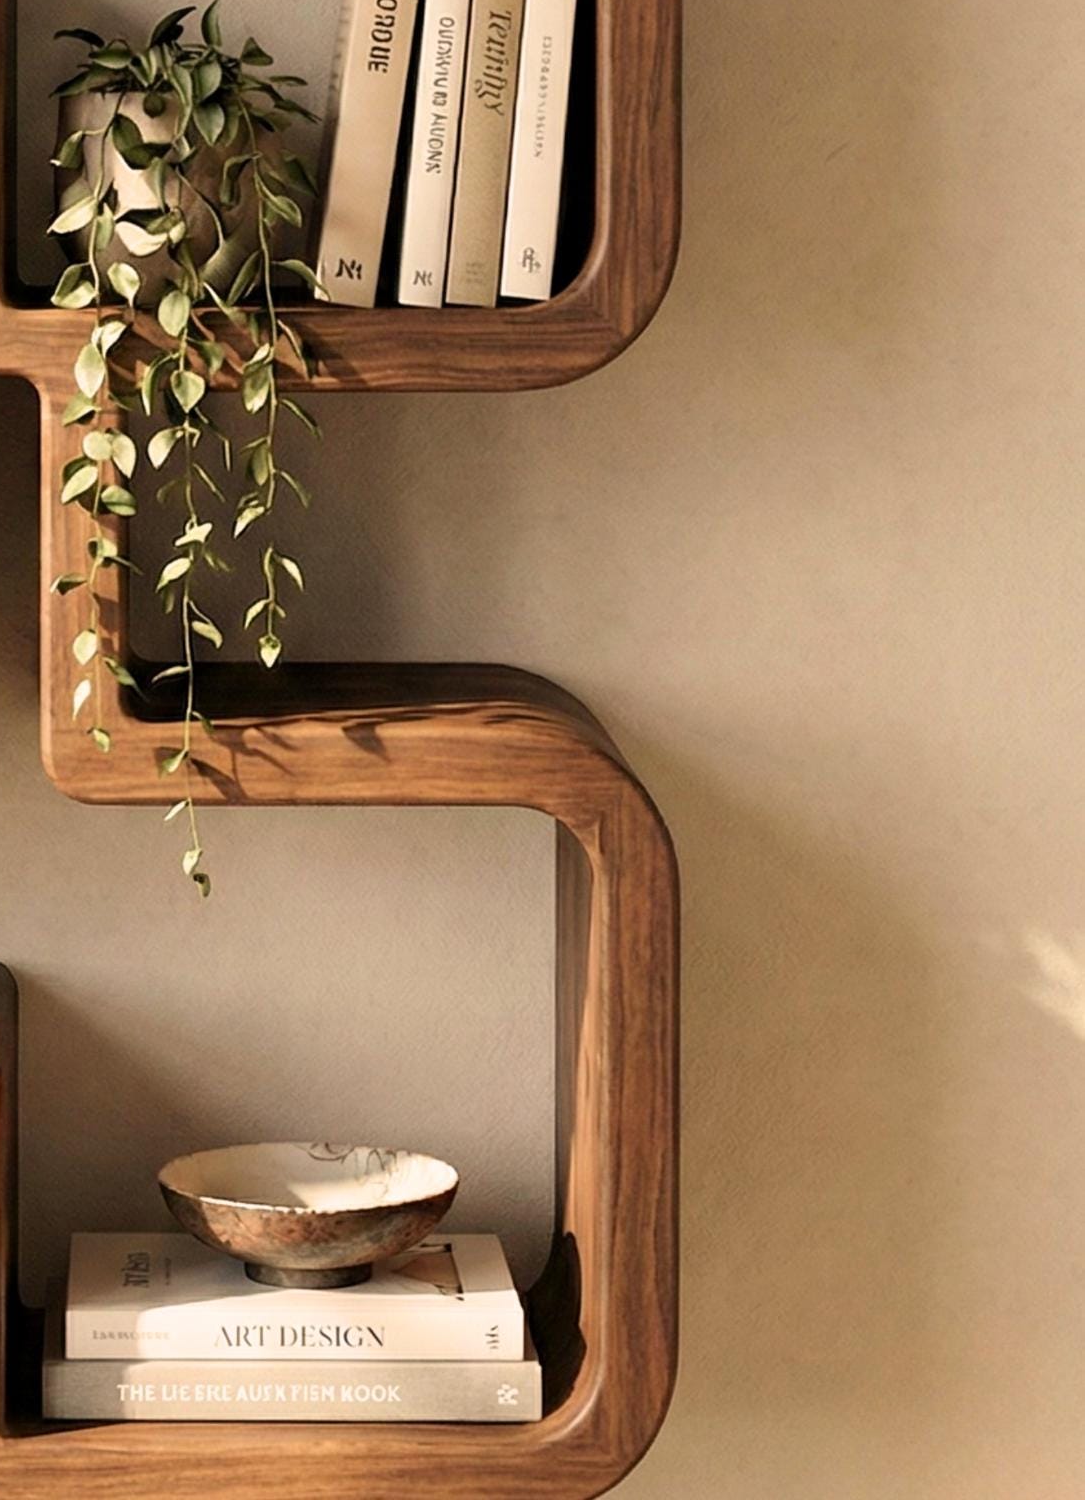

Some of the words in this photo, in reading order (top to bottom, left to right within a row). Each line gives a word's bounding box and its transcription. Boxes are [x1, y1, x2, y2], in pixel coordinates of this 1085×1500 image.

[214, 1325, 270, 1347] ART
[279, 1325, 385, 1347] DESIGN
[117, 1384, 155, 1403] THE
